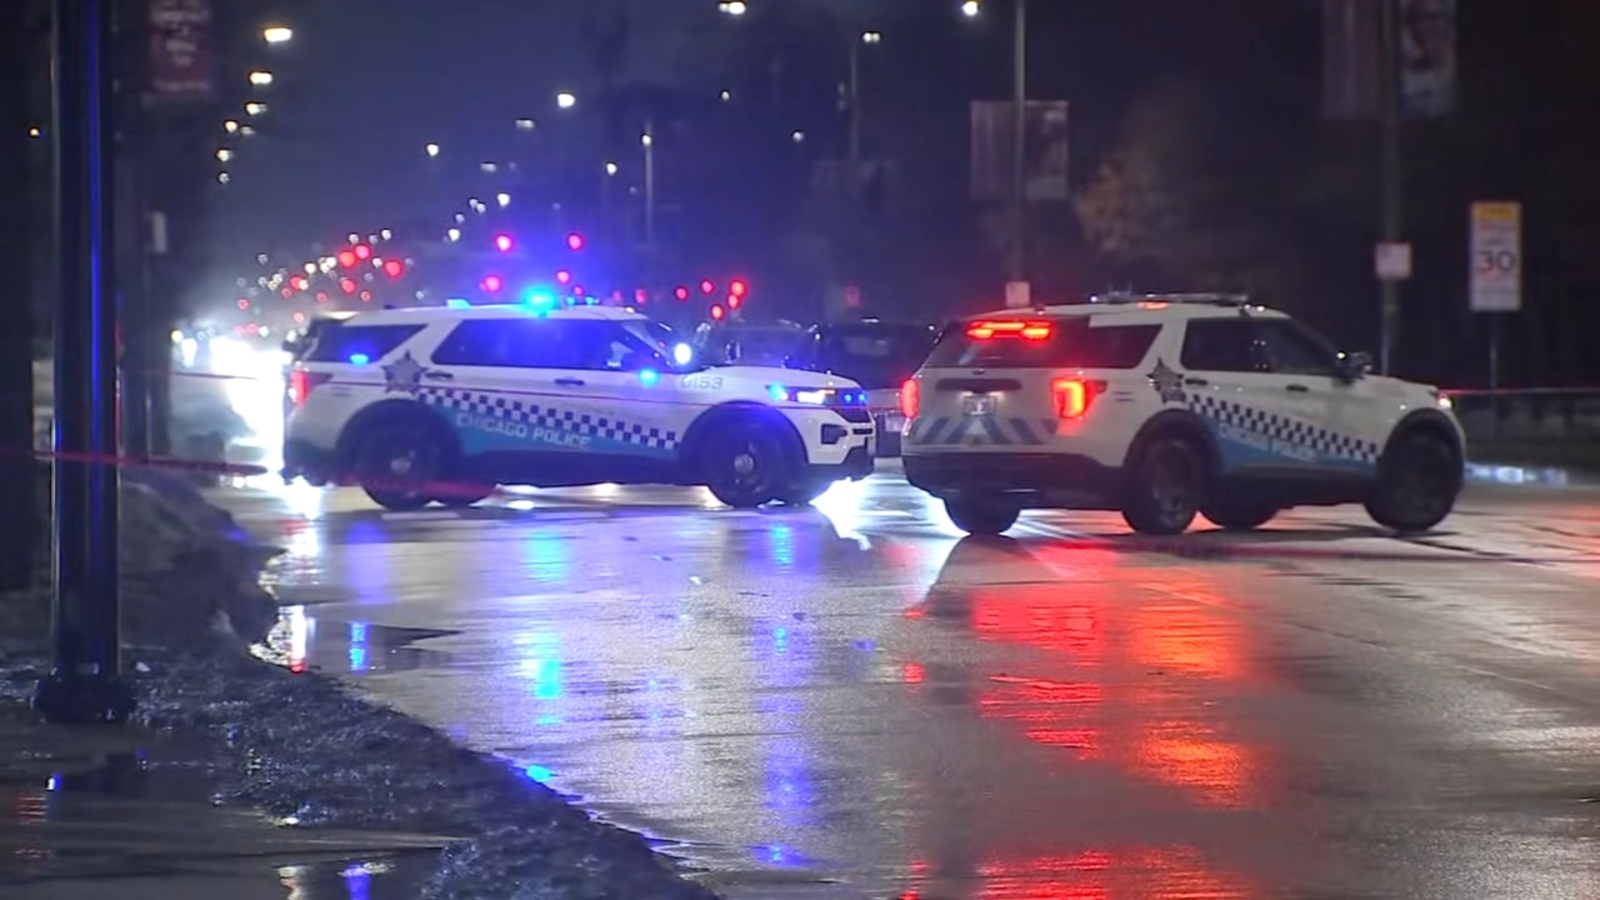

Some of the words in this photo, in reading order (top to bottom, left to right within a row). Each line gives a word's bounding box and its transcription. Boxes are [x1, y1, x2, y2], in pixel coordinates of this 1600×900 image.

[1479, 250, 1516, 272] 30
[455, 412, 528, 438] CHICAGO
[533, 427, 592, 449] POLICE
